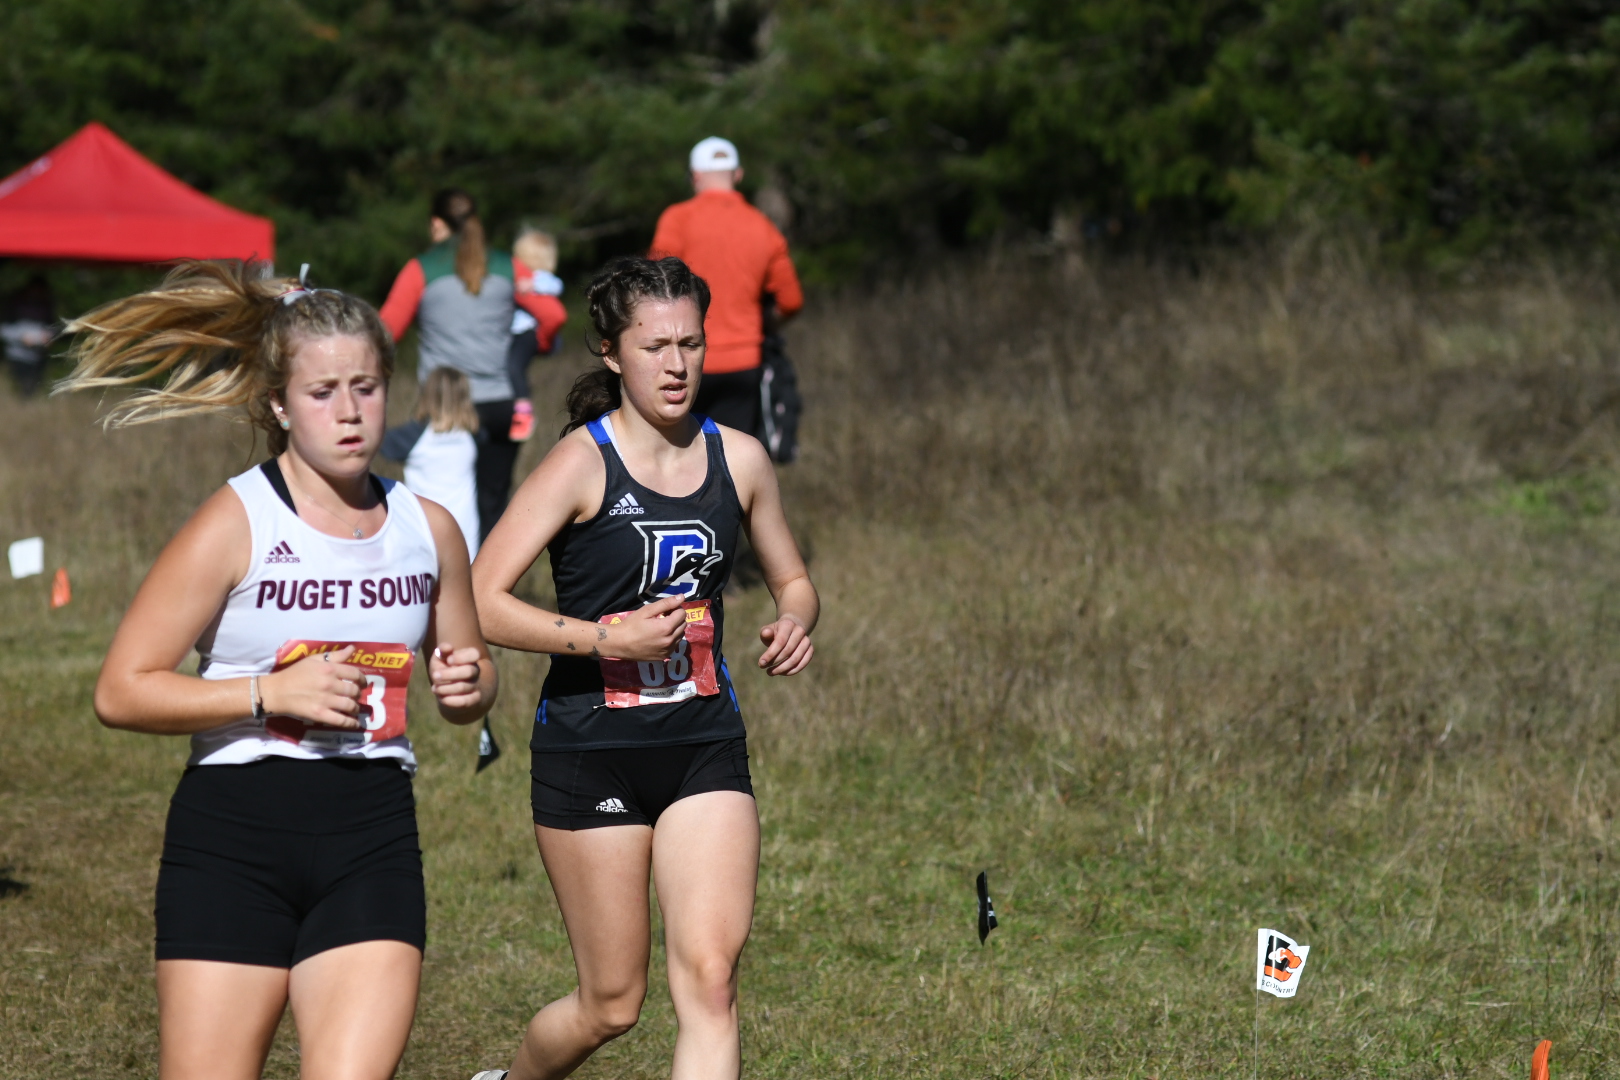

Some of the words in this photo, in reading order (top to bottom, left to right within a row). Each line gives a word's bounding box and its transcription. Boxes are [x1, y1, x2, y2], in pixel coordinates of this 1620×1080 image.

[609, 506, 645, 516] adidas
[264, 554, 301, 564] adidas
[255, 579, 353, 611] PUGET
[377, 656, 404, 666] NET
